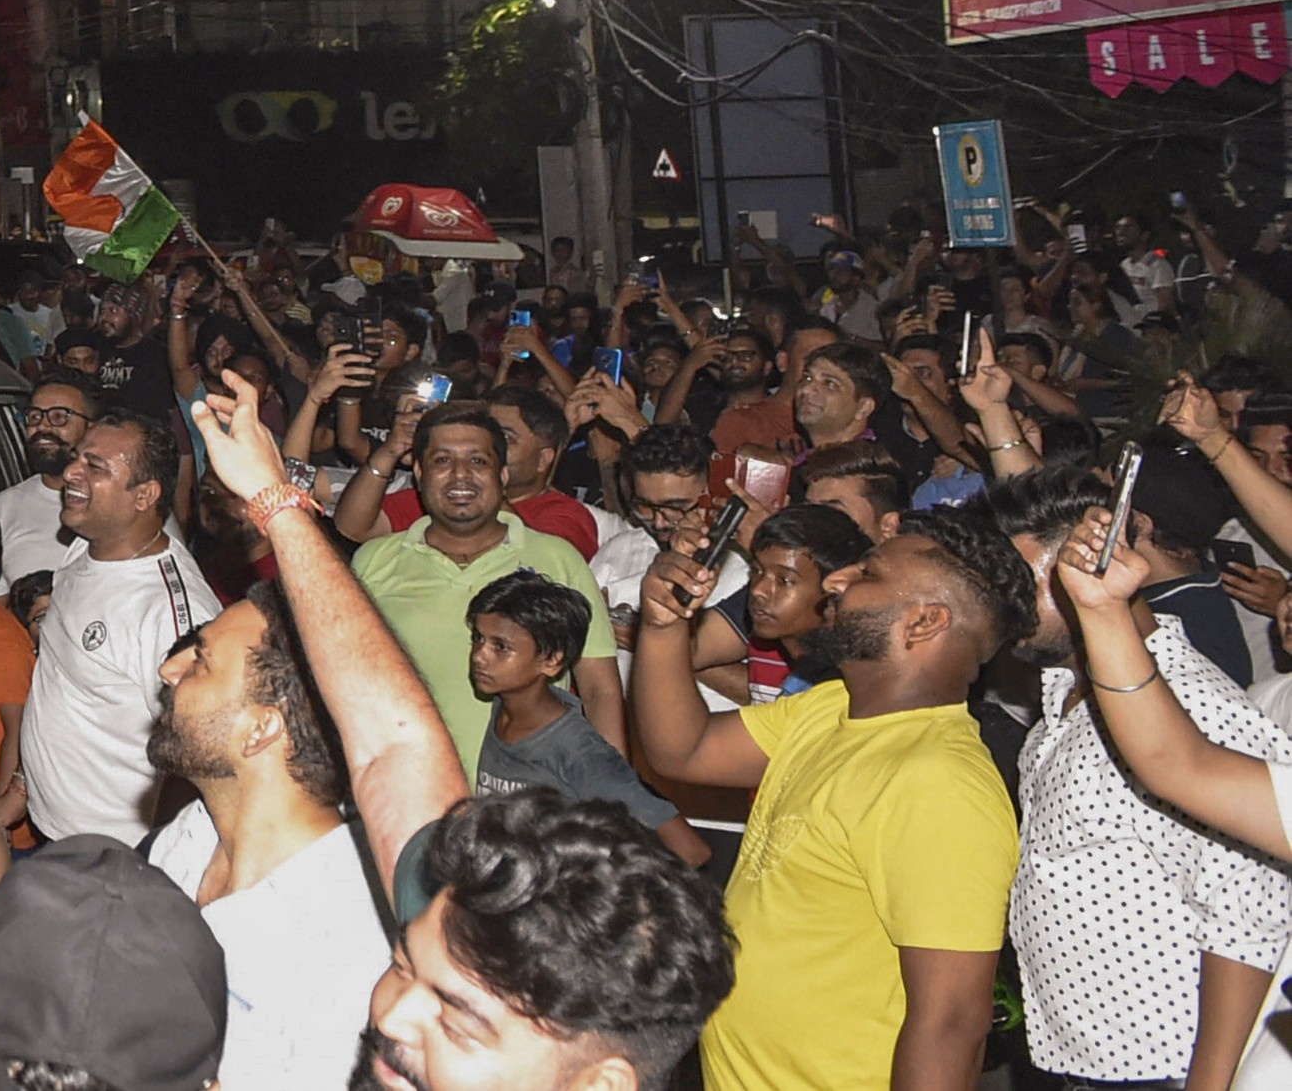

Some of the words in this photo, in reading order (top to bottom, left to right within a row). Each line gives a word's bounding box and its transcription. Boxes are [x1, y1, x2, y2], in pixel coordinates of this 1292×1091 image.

[1101, 21, 1273, 77] SALE
[964, 146, 977, 175] P
[176, 604, 187, 625] 1890
